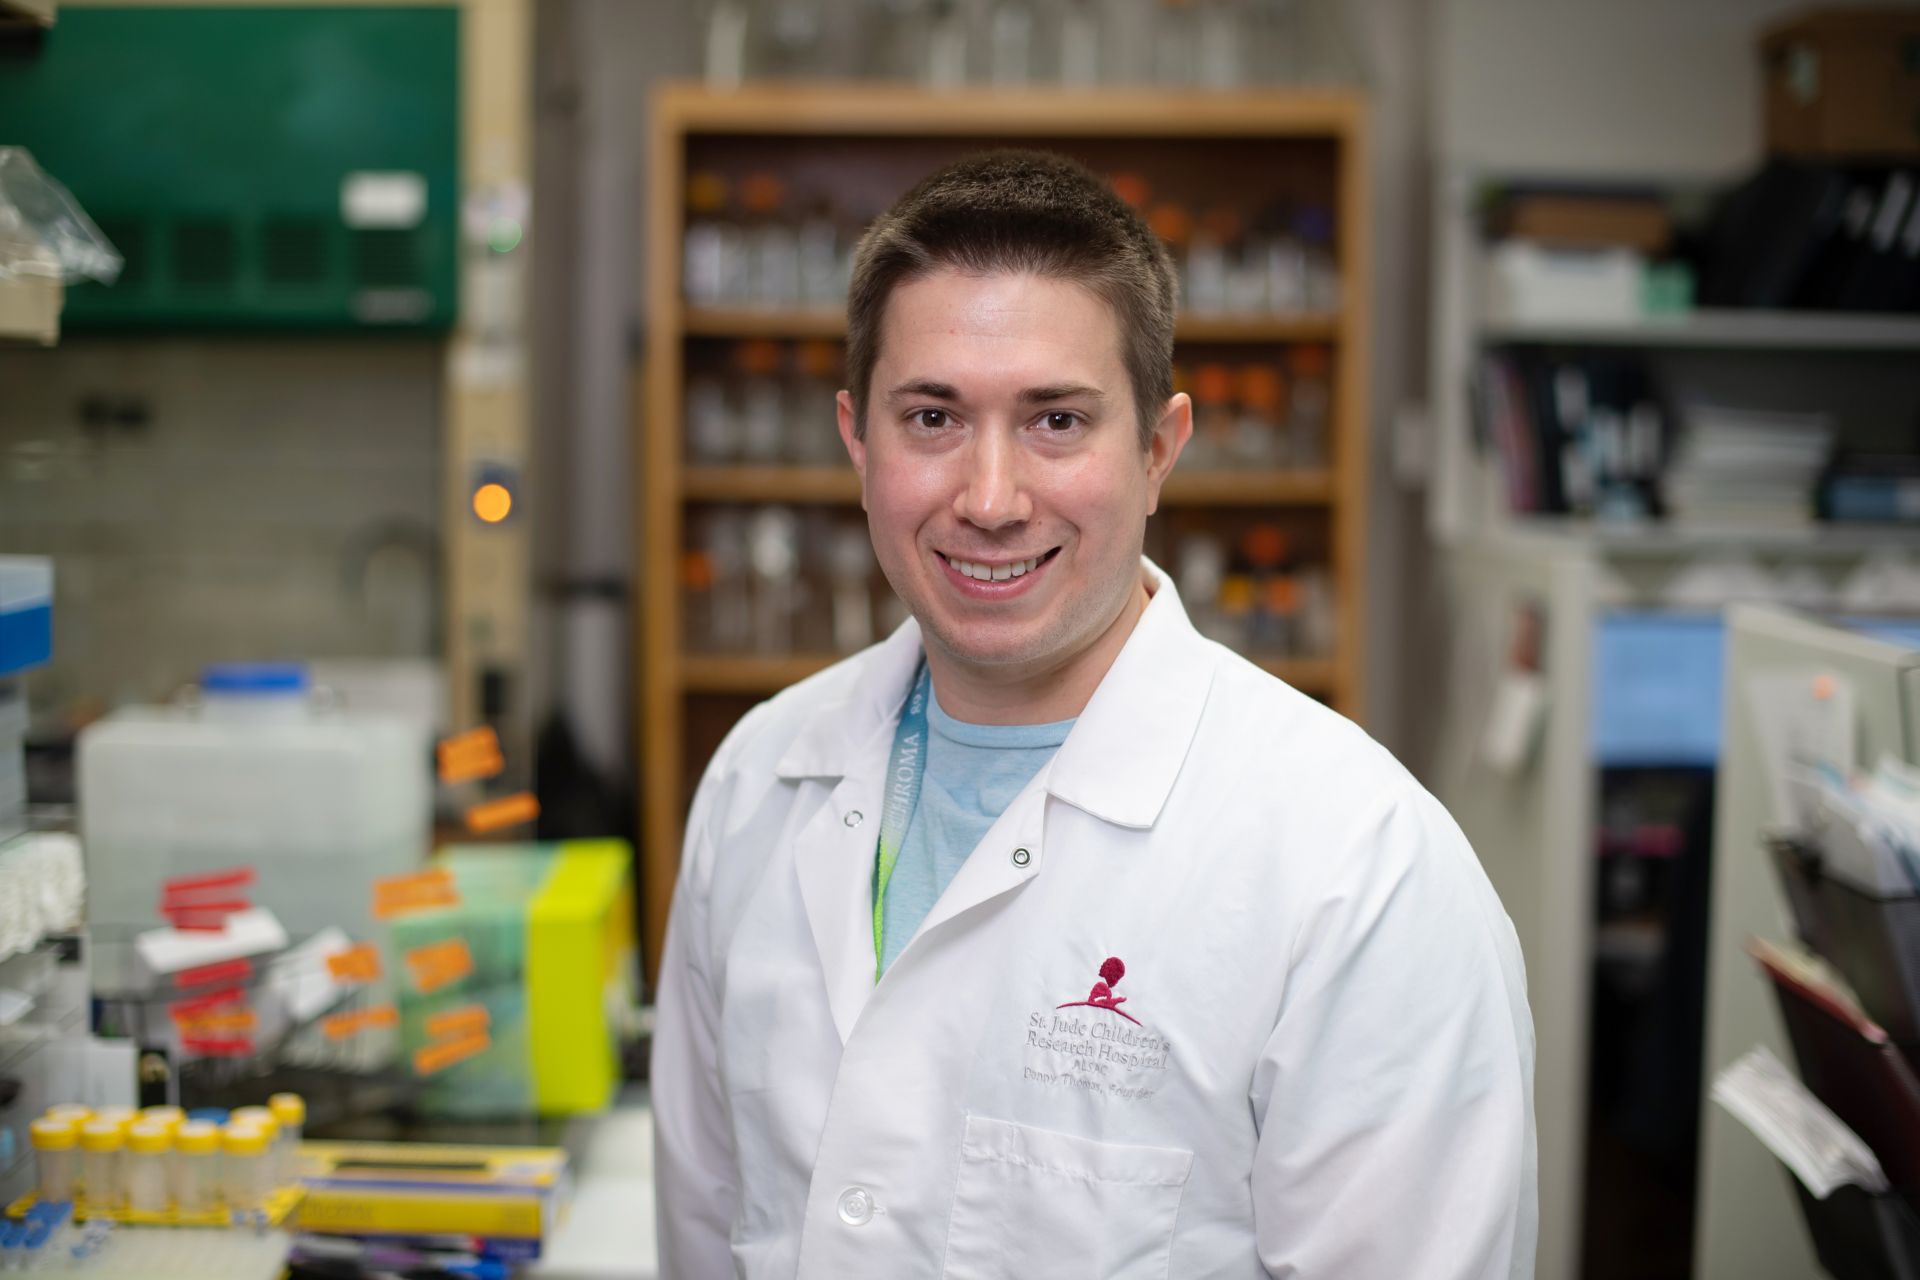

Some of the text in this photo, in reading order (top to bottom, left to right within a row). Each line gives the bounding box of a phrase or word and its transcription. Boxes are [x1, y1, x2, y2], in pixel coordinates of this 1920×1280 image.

[891, 732, 919, 829] CHROMA
[1026, 1030, 1168, 1071] Research Hospital
[1029, 1012, 1171, 1052] St. Jude Children's
